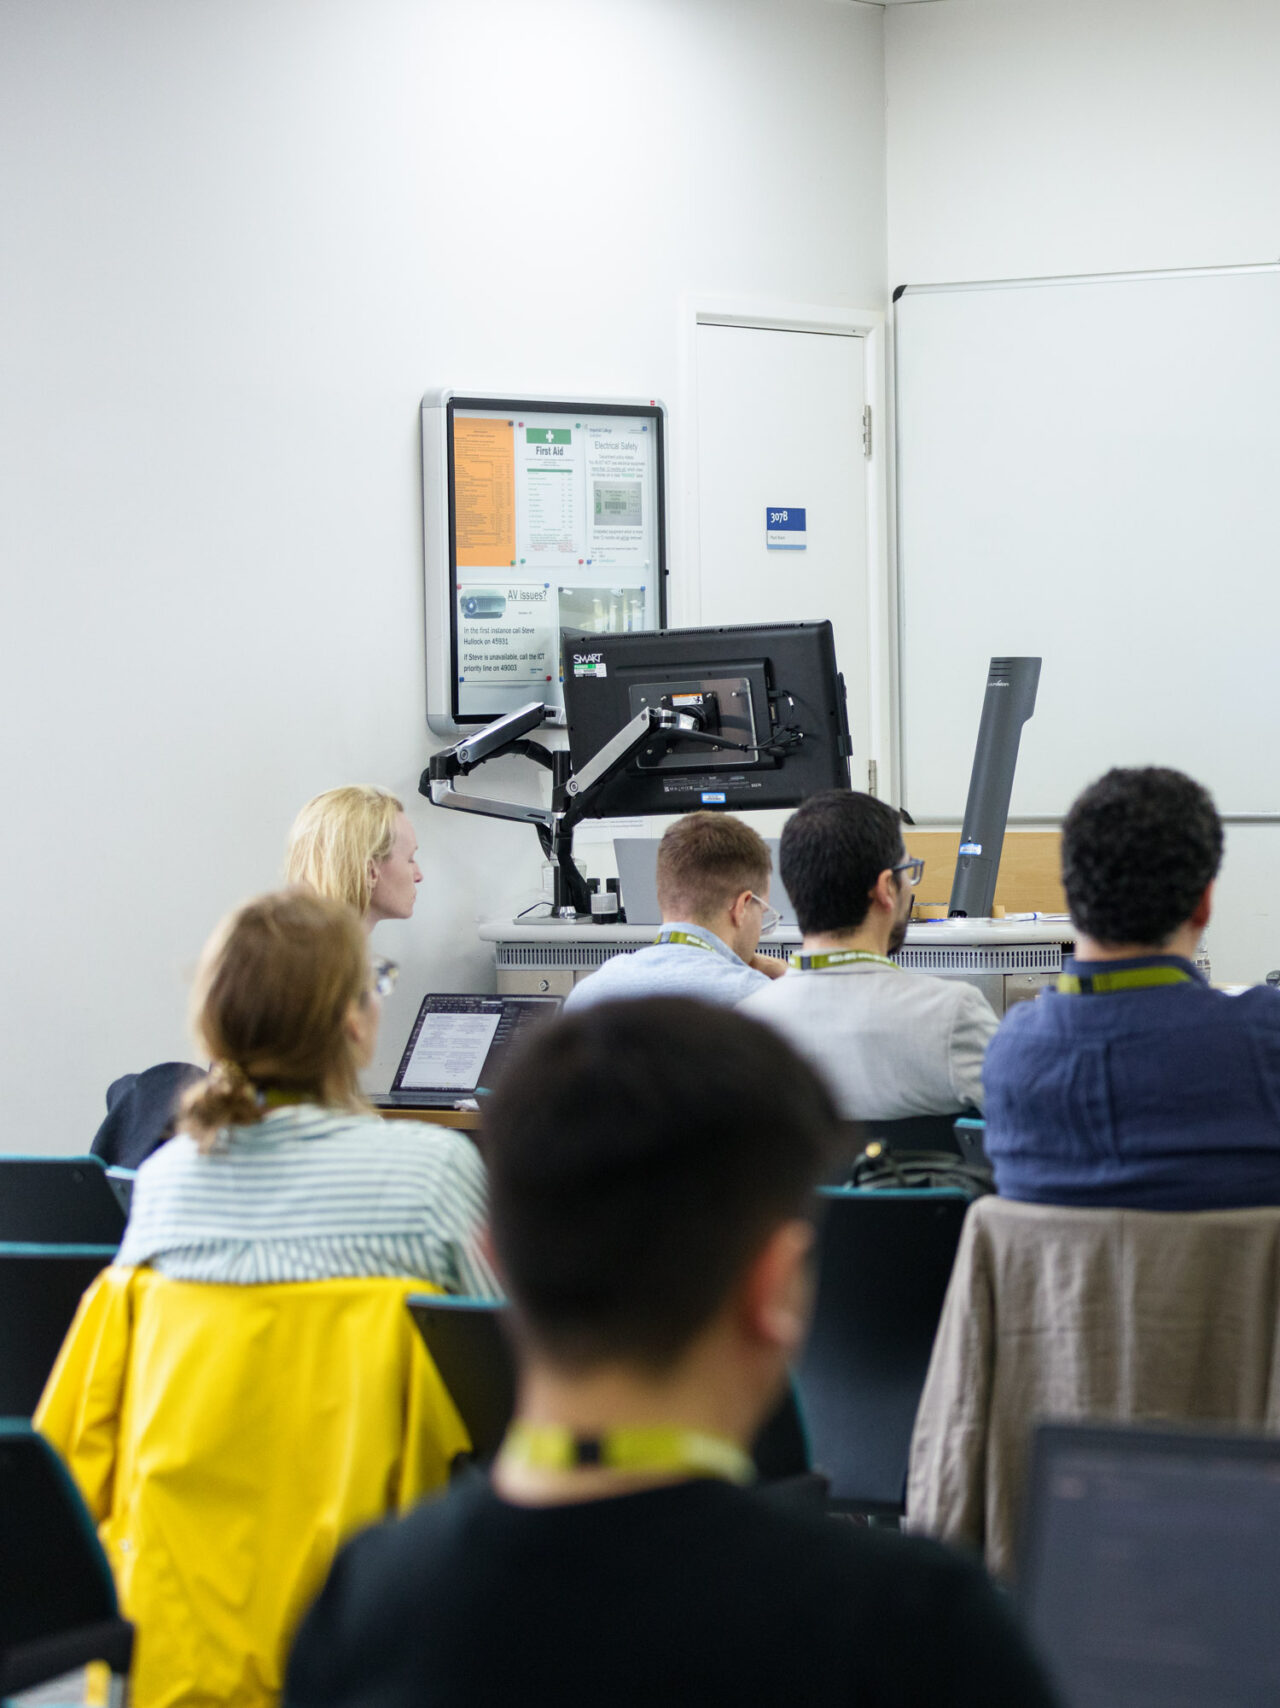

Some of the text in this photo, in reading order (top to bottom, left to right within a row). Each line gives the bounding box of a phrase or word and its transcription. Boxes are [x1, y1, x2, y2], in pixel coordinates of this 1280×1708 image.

[536, 446, 564, 456] First Aid
[770, 511, 788, 523] 3078
[508, 589, 547, 600] AV issues?
[573, 653, 603, 664] SMART
